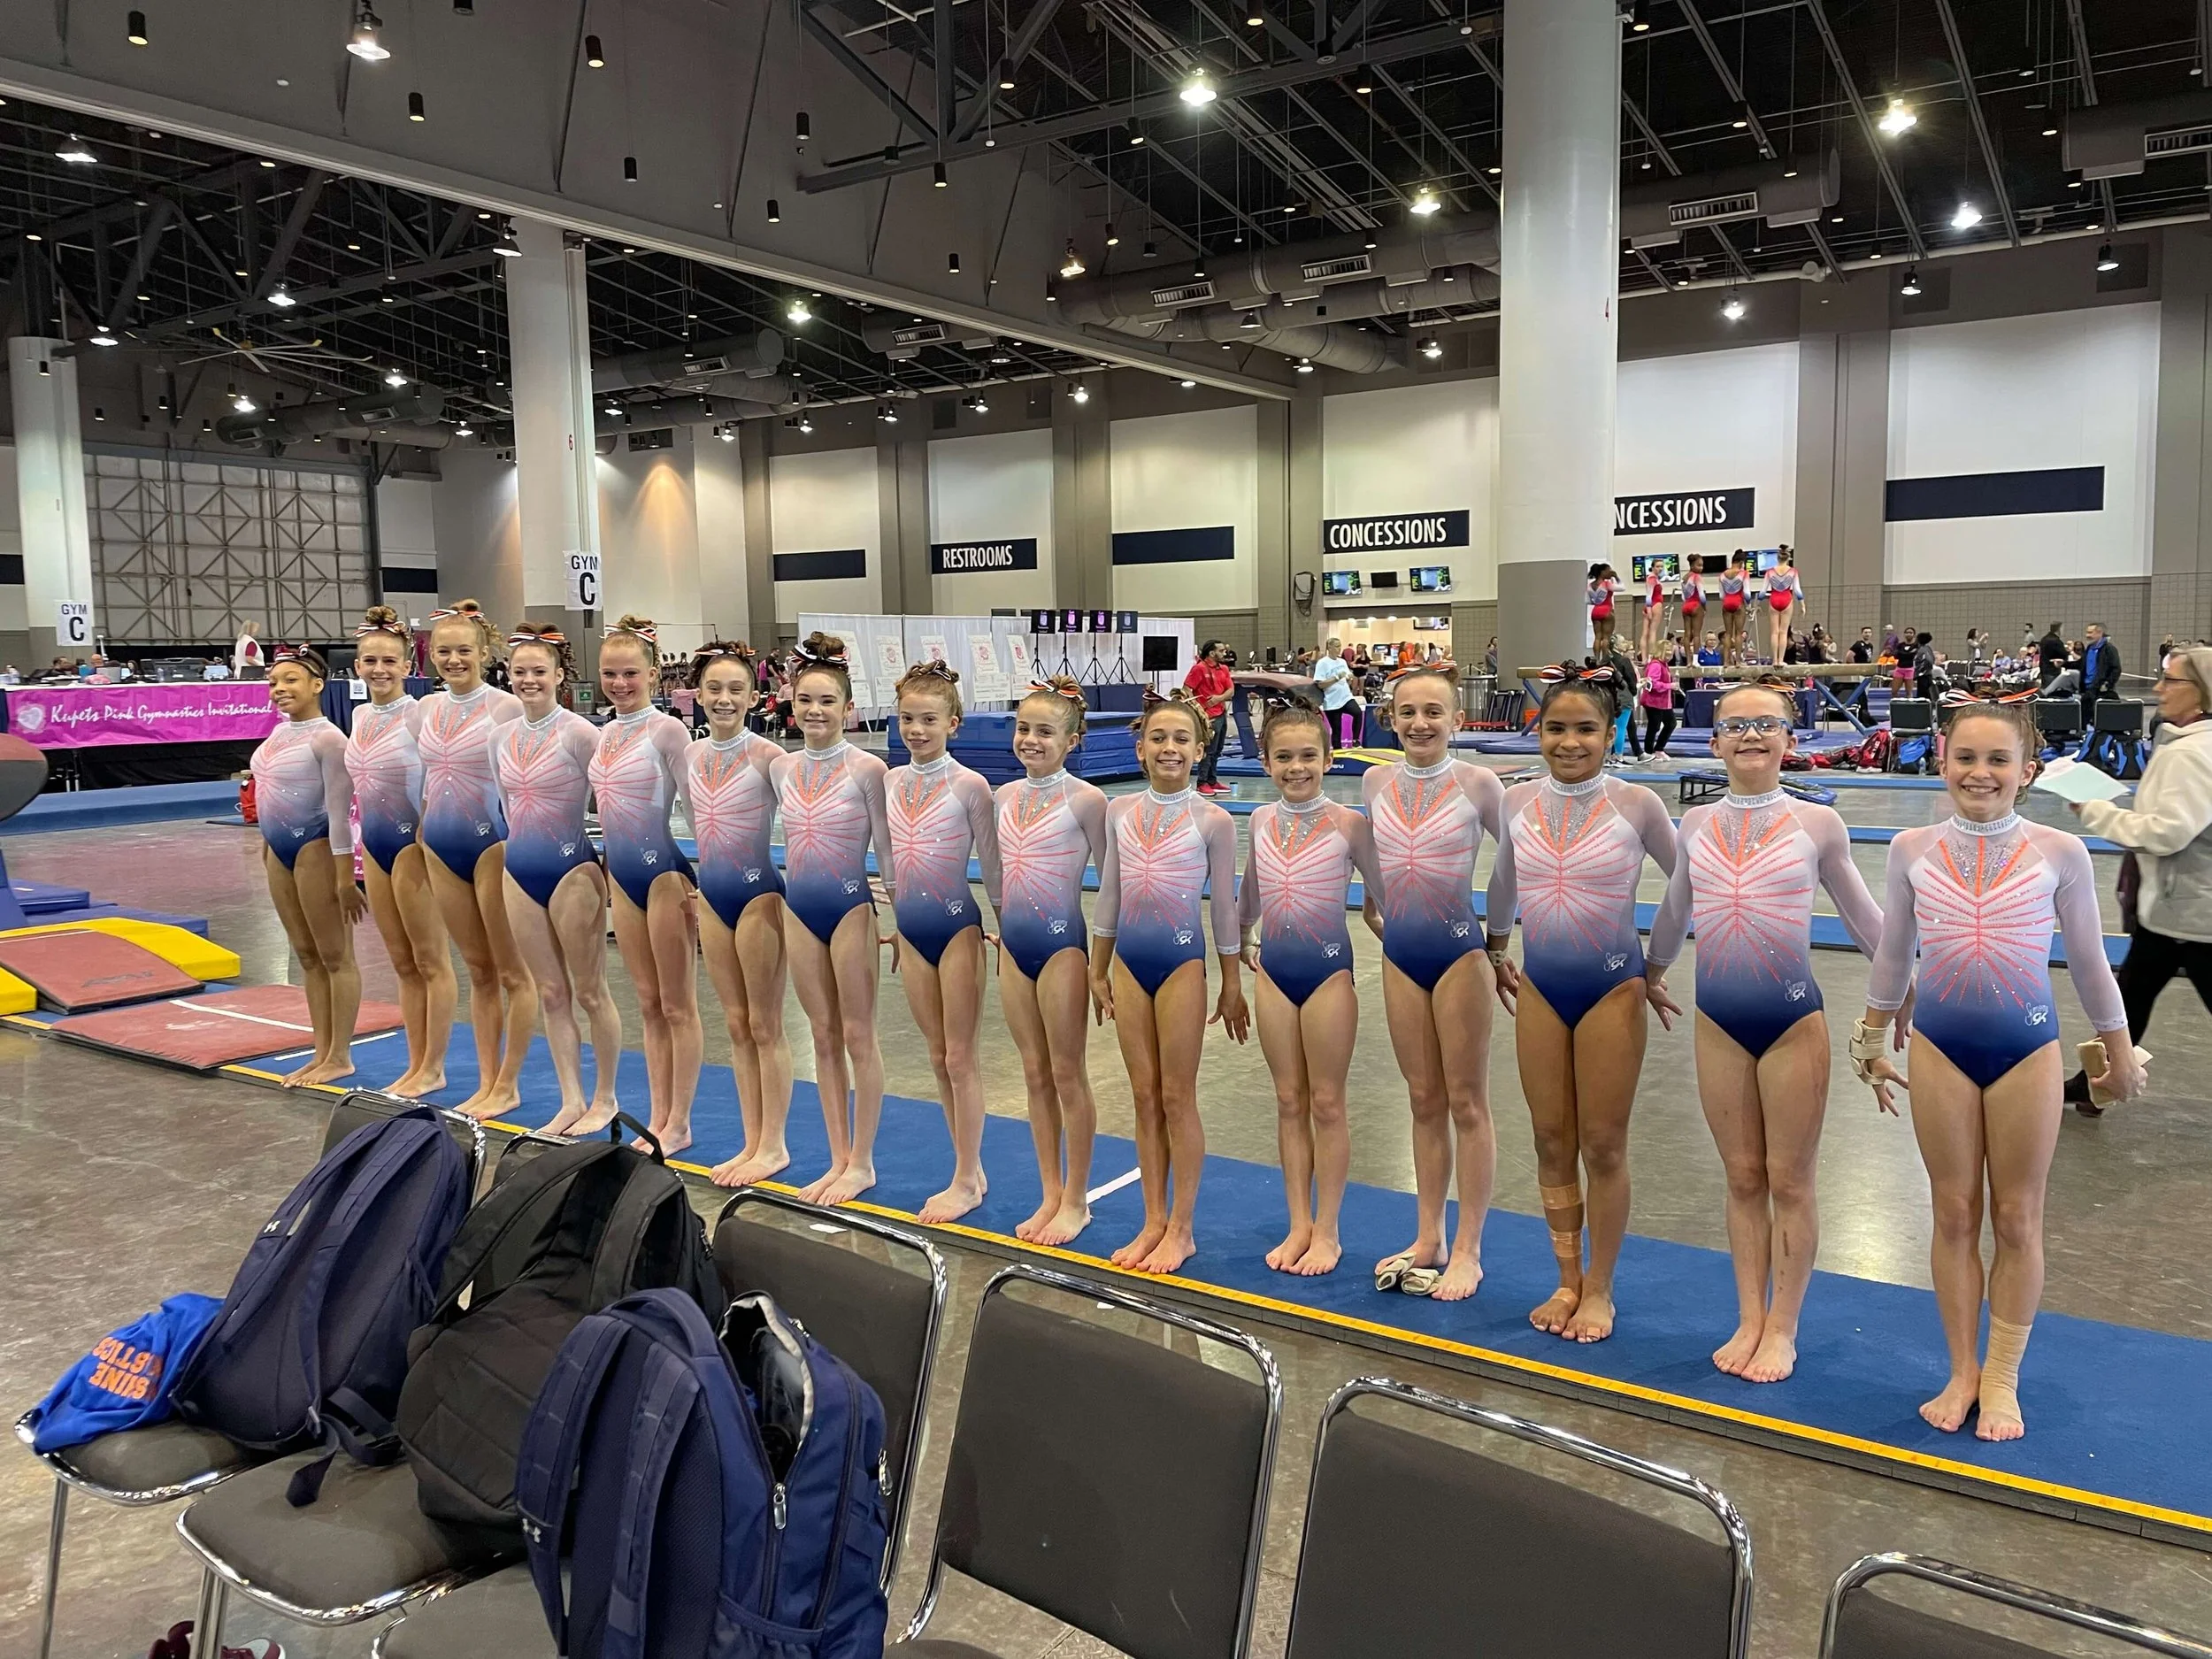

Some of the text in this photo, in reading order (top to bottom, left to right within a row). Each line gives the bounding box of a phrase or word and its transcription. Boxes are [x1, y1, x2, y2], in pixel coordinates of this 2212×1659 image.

[1614, 495, 1727, 530] NCESSIONS
[1329, 517, 1447, 549] CONCESSIONS
[942, 544, 1013, 569] RESTROOMS
[579, 572, 595, 605] C
[61, 603, 88, 615] GYM
[69, 616, 85, 641] C
[50, 699, 273, 729] Kupets Pink Gymnastics Invitational
